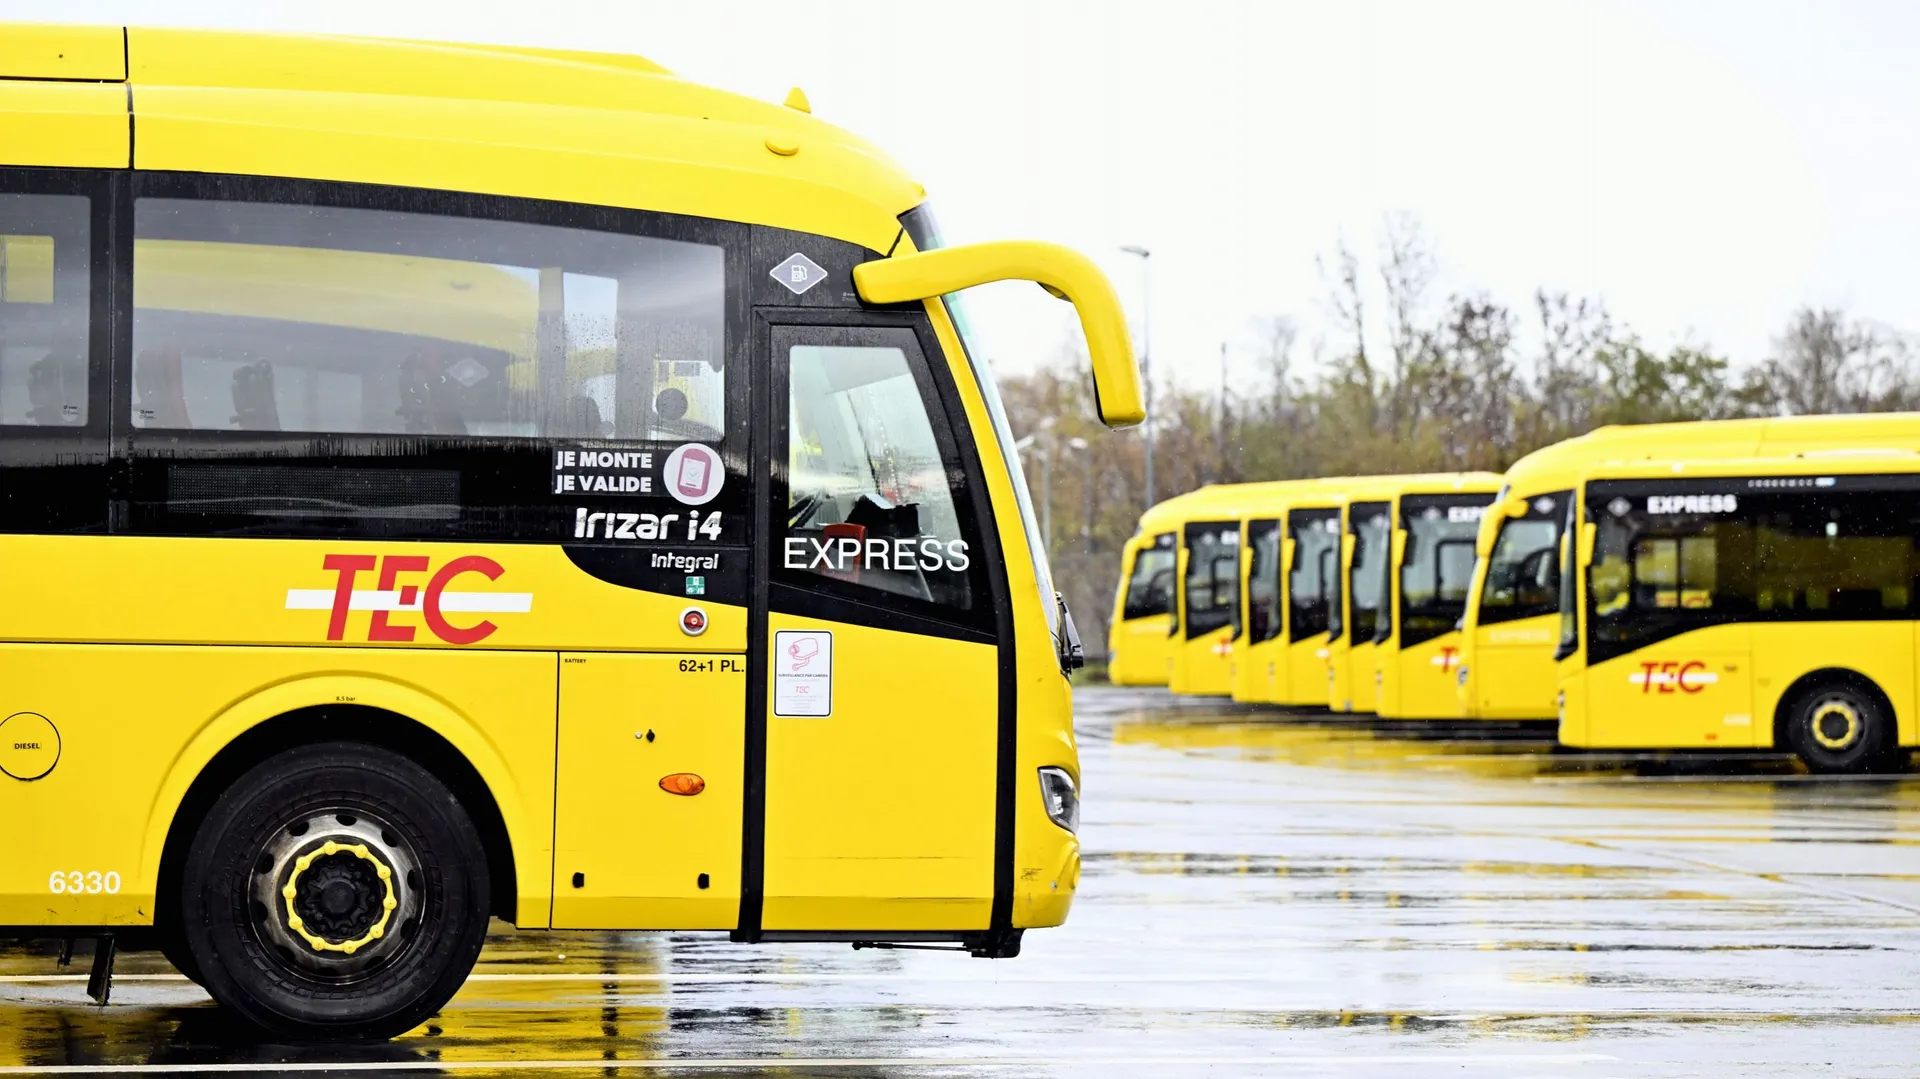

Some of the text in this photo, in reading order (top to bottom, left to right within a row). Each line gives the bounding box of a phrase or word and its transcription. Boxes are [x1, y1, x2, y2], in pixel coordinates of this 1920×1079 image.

[555, 451, 652, 470] JE MONTE
[555, 475, 652, 494] JE VALIDE
[1647, 494, 1738, 514] EXPRESS
[574, 507, 722, 541] Irizar i4
[651, 552, 719, 573] Integral
[784, 537, 970, 571] EXPRESS
[322, 554, 506, 645] TEC
[678, 659, 745, 673] 62+1 PL.
[1640, 661, 1706, 694] TEC
[14, 742, 40, 750] DIESEL
[49, 870, 121, 894] 6330
